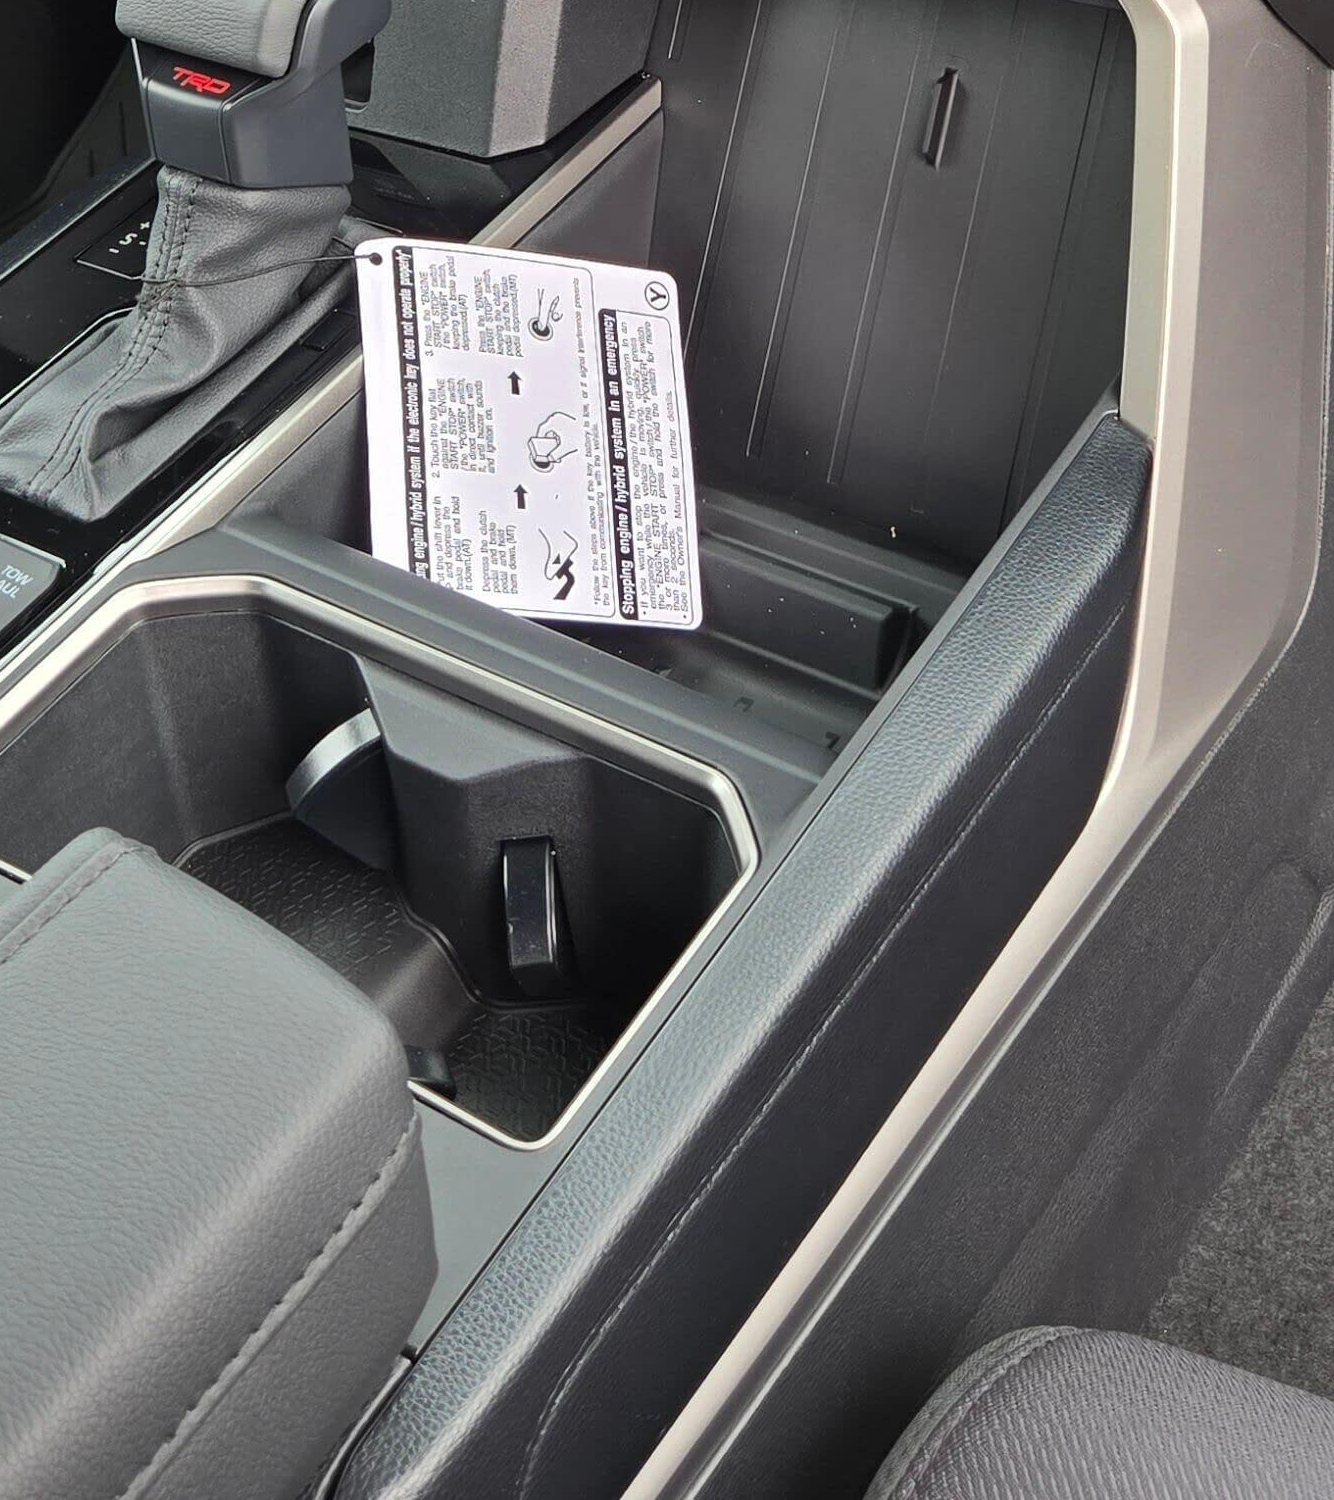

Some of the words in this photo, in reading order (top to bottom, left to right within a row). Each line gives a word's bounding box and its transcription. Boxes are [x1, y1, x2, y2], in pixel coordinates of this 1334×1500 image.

[173, 66, 231, 94] TRD
[119, 232, 138, 245] S
[649, 288, 666, 302] Y
[603, 314, 619, 375] emergency
[608, 380, 619, 395] an
[608, 399, 620, 411] in
[610, 416, 626, 459] system
[0, 564, 34, 587] TOW
[619, 559, 636, 614] Stopping
